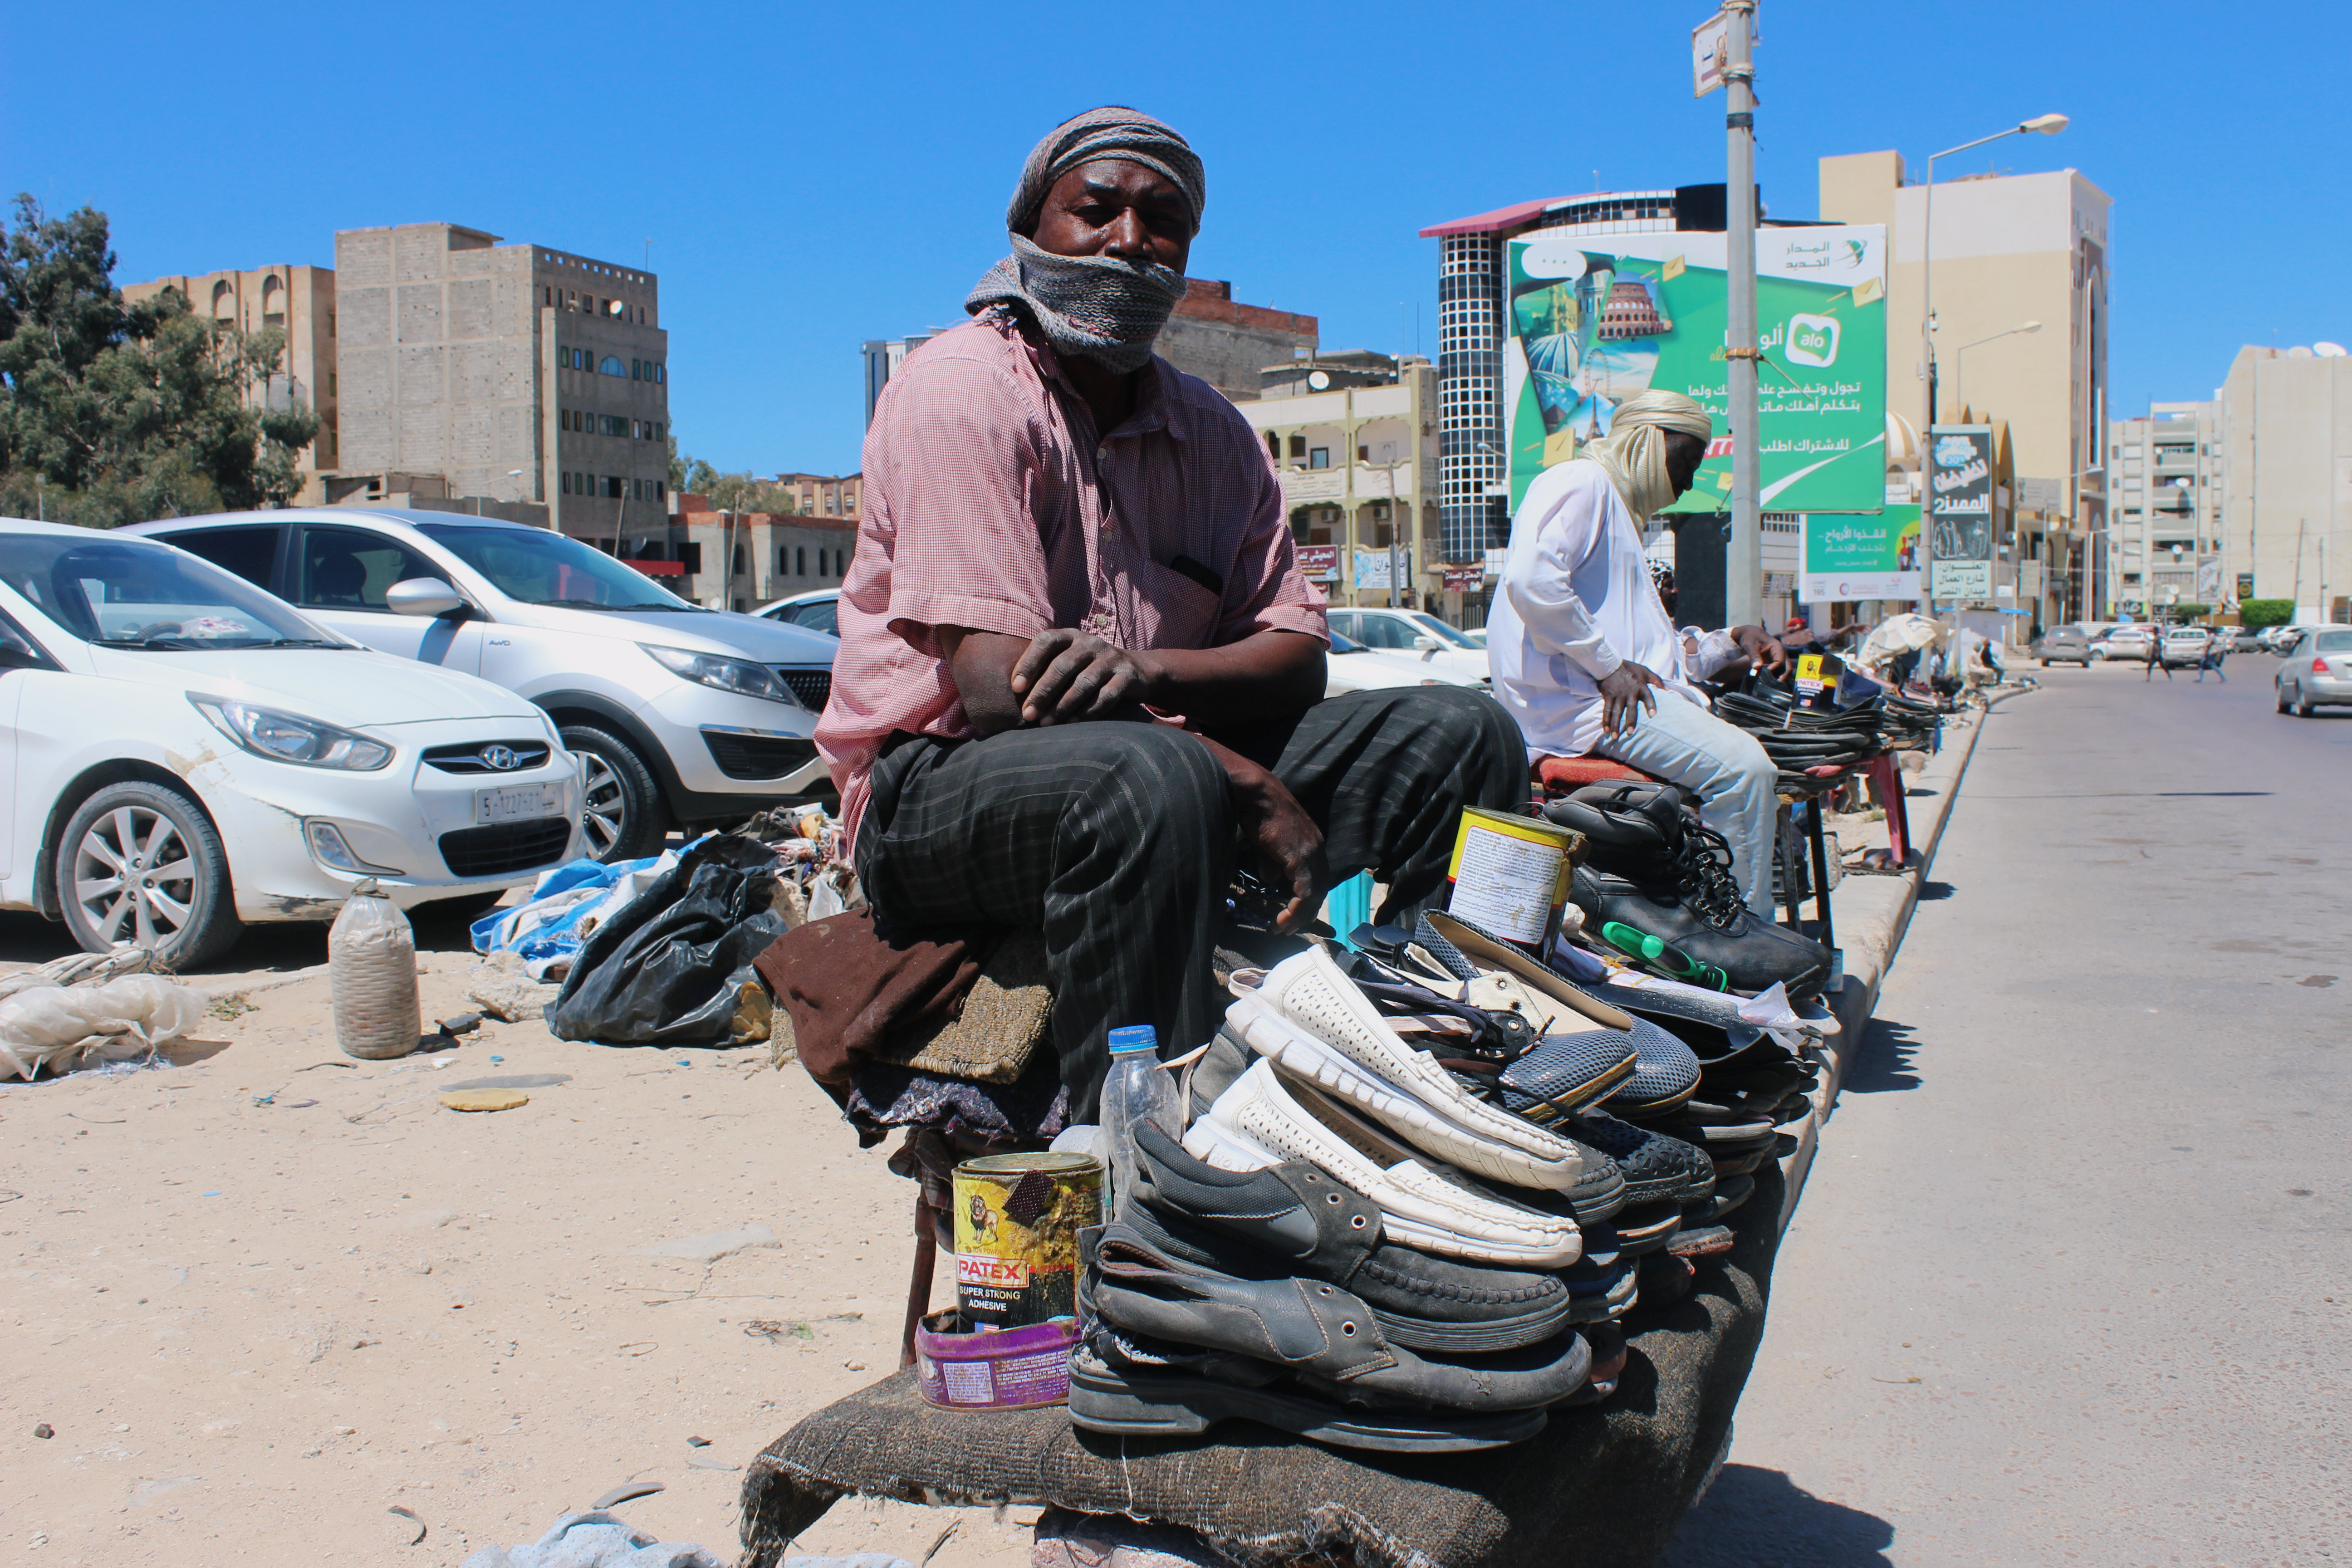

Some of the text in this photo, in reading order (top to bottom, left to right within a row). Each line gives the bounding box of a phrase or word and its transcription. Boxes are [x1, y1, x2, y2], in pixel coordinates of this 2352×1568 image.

[1786, 241, 1829, 255] المدار
[1786, 257, 1829, 270] الجديد
[1800, 333, 1825, 348] alo
[1794, 438, 1850, 454] للاشتراك
[959, 1259, 1020, 1279] PATEX
[959, 1285, 1020, 1300] SUPER STRONG
[968, 1298, 1007, 1312] ADHESIVE
